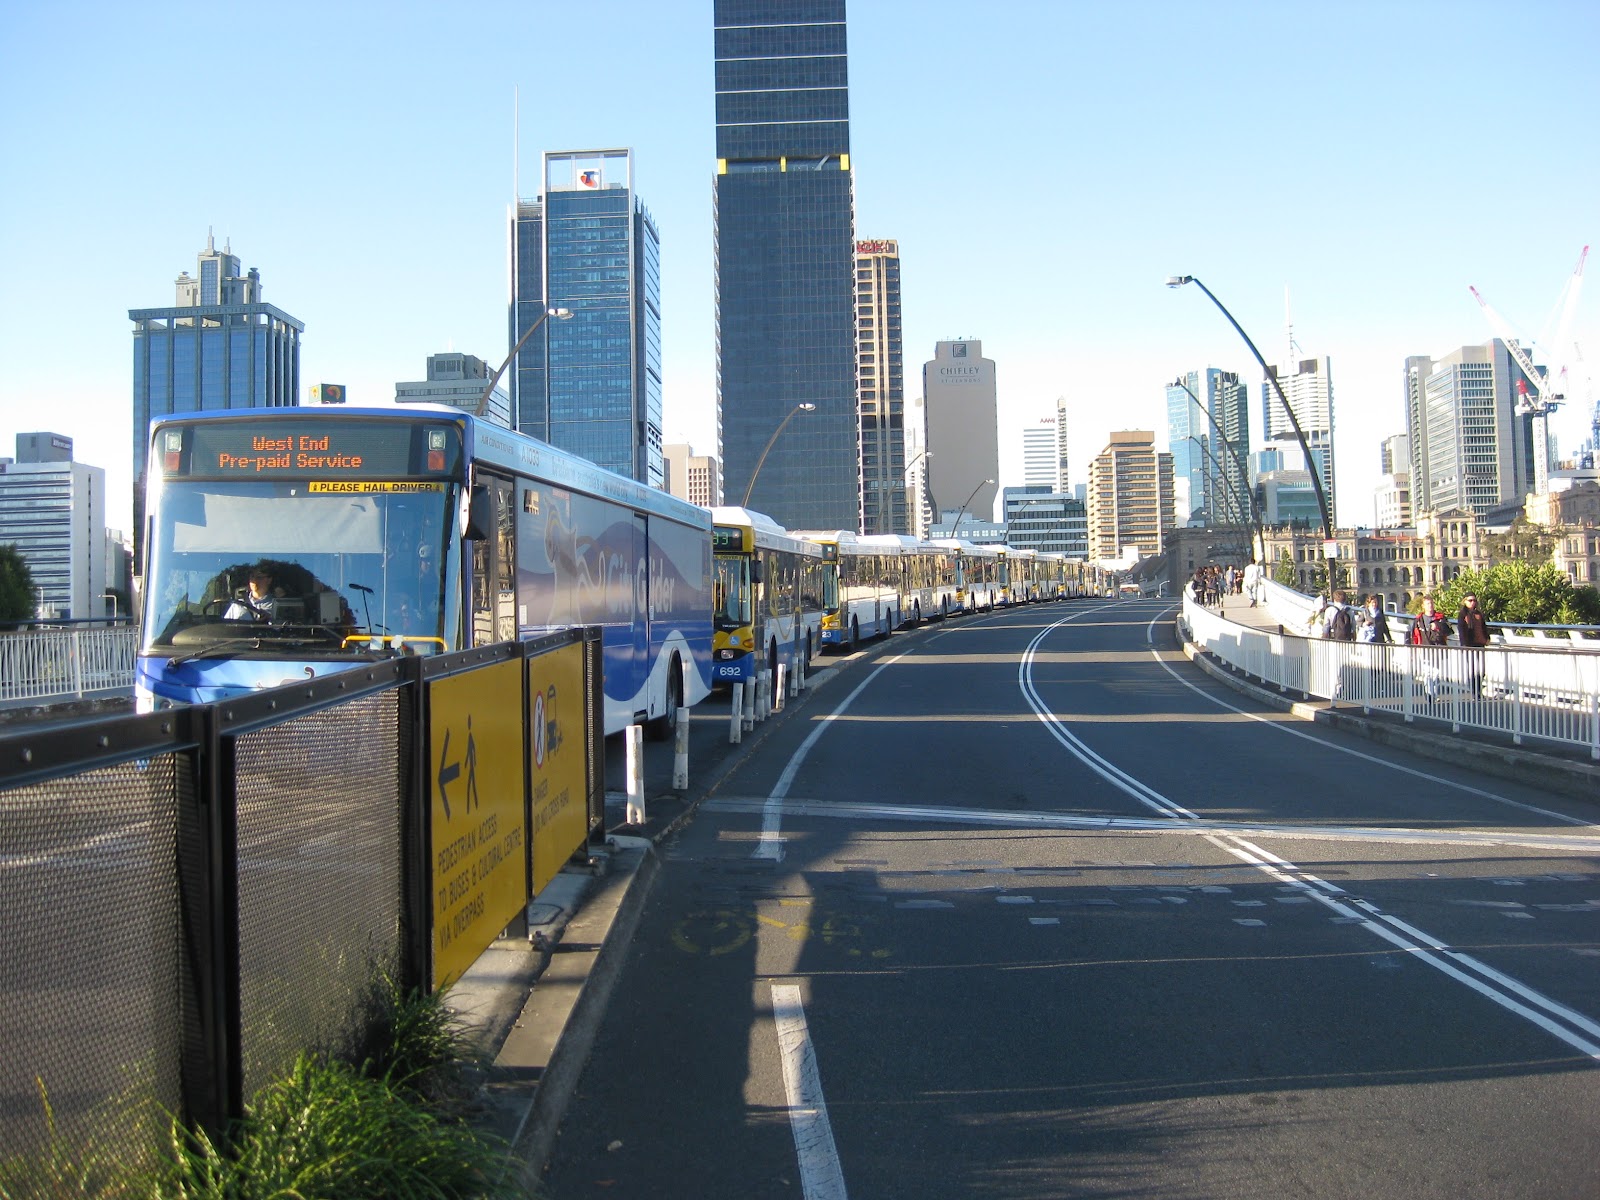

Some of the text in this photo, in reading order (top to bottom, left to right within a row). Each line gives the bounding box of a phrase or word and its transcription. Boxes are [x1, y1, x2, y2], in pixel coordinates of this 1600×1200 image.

[940, 366, 980, 375] CHIFLEY
[253, 436, 329, 450] West End
[219, 453, 362, 471] Pre-paid Service
[320, 483, 432, 492] PLEASE HAIL DRIVER
[608, 553, 675, 628] CityGlider
[719, 666, 741, 676] 692
[438, 813, 497, 877] PEDESTRIAN ACCESS
[439, 887, 447, 914] TO
[449, 868, 469, 906] BUSES
[479, 842, 503, 881] CULTURAL
[504, 826, 522, 857] CENTRE
[440, 891, 484, 951] VIA OVERPASS
